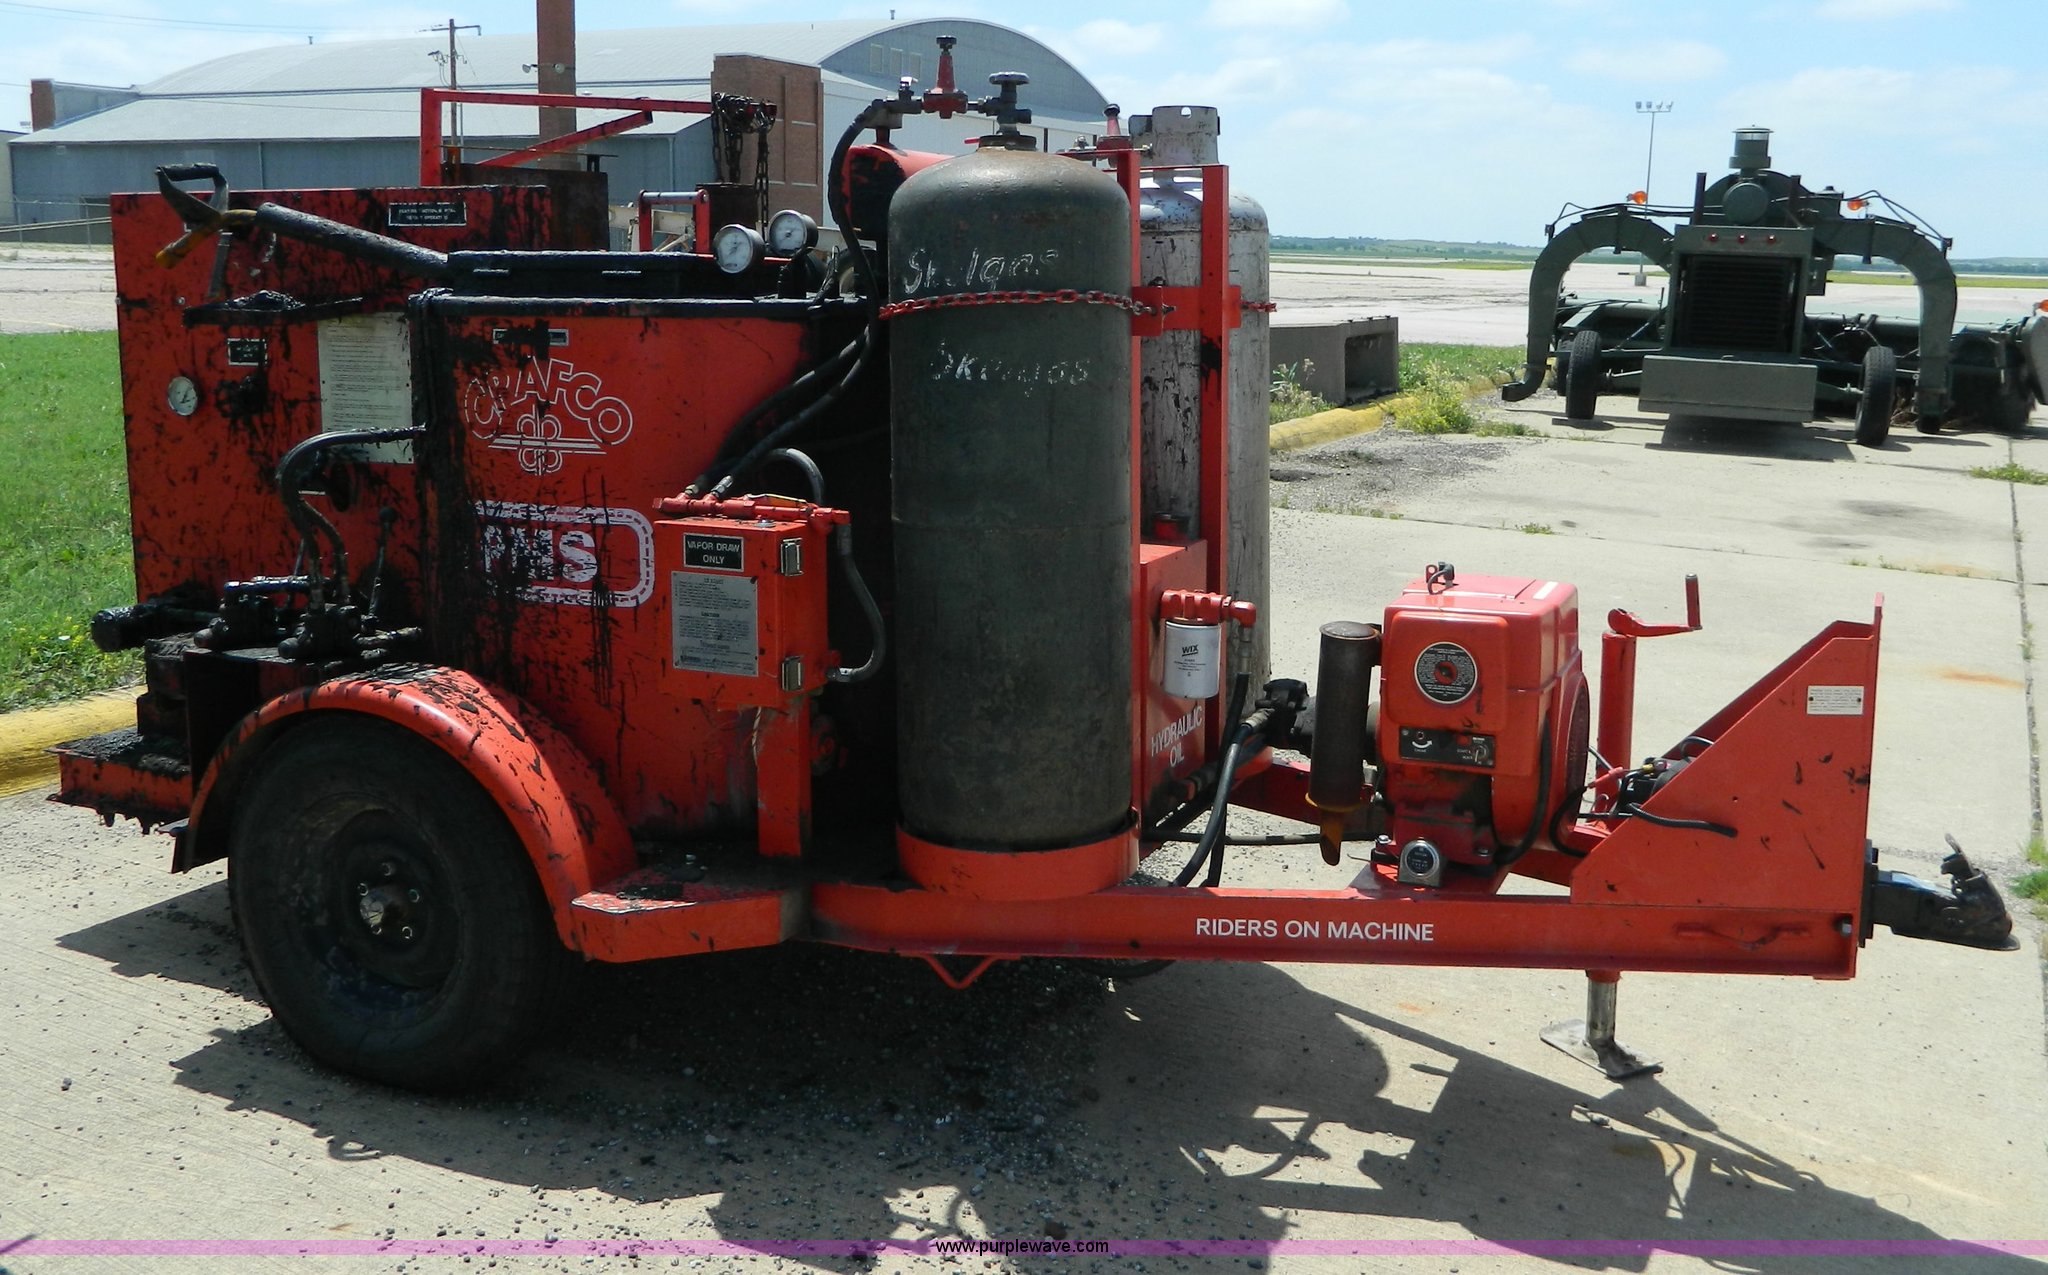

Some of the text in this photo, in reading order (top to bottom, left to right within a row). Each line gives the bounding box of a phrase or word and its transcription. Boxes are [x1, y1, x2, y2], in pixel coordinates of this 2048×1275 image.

[716, 542, 740, 552] DRAW
[702, 554, 725, 564] ONLY
[1181, 644, 1199, 655] WIX
[1151, 705, 1203, 757] HYDRAULIC
[1169, 742, 1185, 767] OIL
[1196, 918, 1434, 941] RIDERS ON MACHINE
